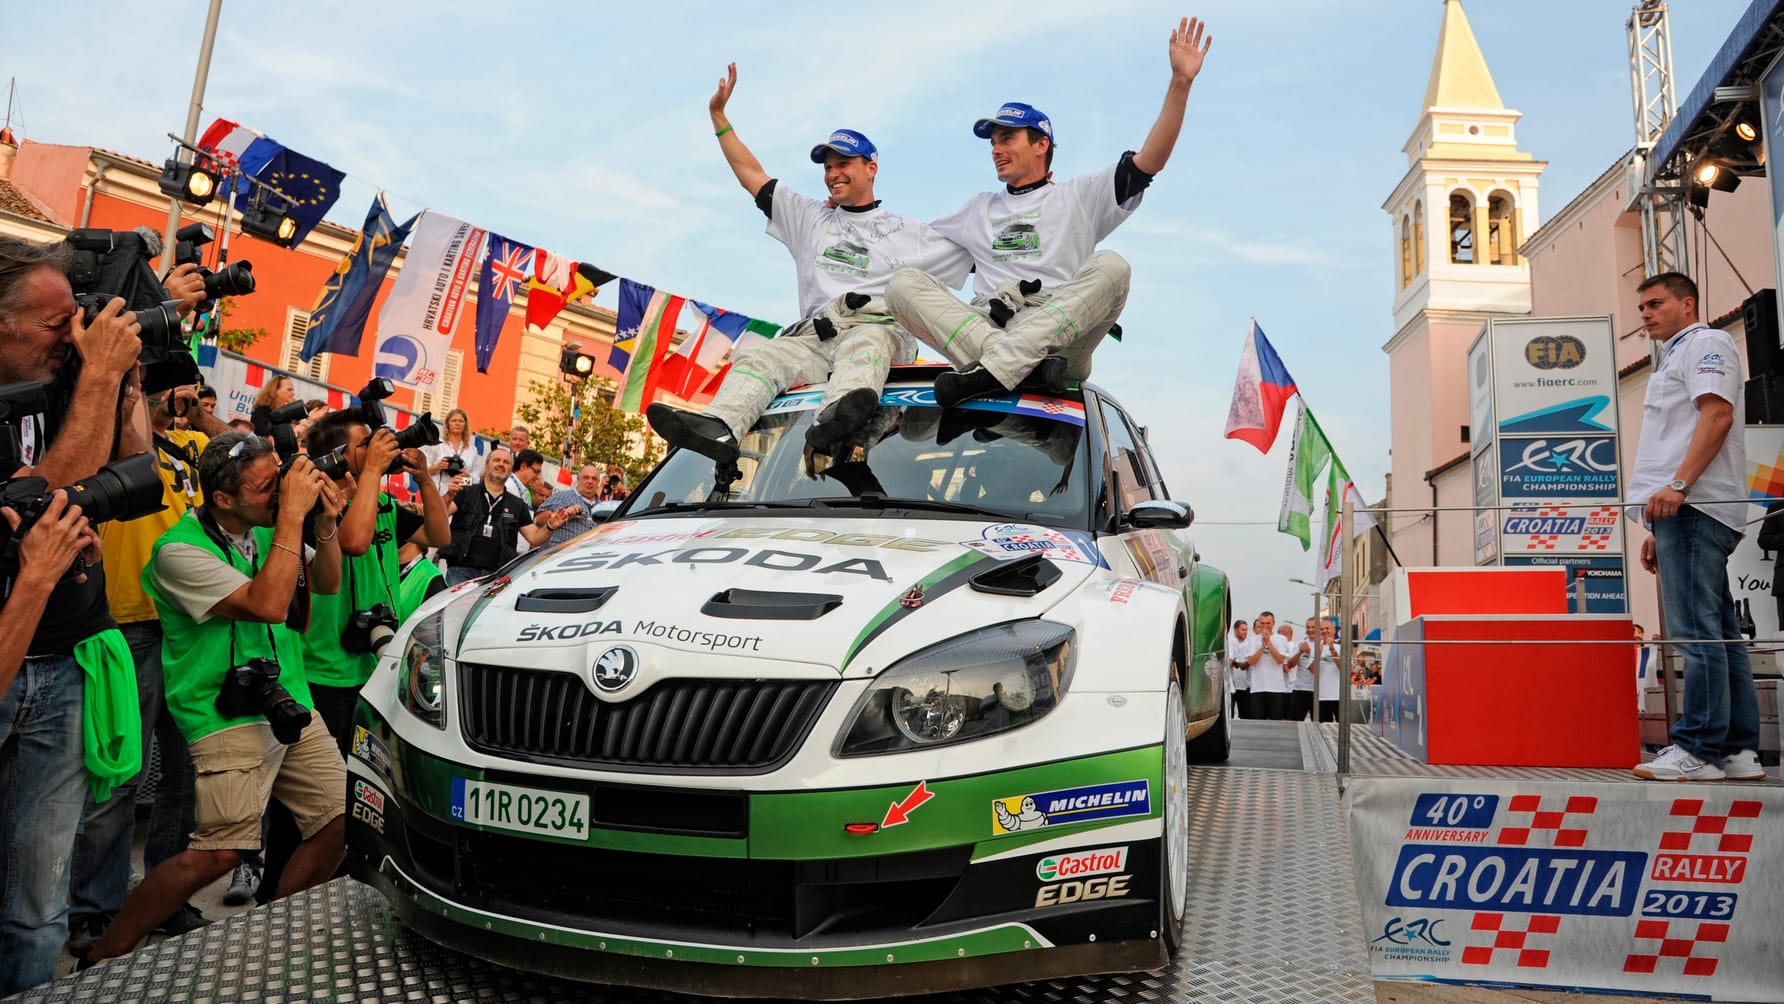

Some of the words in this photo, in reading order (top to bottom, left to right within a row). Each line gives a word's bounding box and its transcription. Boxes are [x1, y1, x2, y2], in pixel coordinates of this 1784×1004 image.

[423, 292, 442, 330] HRVATSKI
[435, 272, 449, 292] AUTO
[444, 240, 462, 267] KARTING
[1513, 377, 1597, 388] www.fiaerc.com
[229, 389, 257, 404] Unit
[1503, 475, 1521, 483] FIA
[1522, 483, 1616, 491] CHAMPIONSHIP
[1506, 519, 1580, 533] CROATIA
[1004, 541, 1054, 551] CROATIA
[544, 546, 890, 581] ŠKODA
[1559, 558, 1591, 566] partners
[517, 620, 622, 642] ŠKODA
[633, 620, 763, 651] Motorsport
[452, 805, 463, 818] CZ
[470, 787, 512, 824] 11R
[518, 793, 584, 833] 0234
[1049, 789, 1147, 812] MICHELIN
[352, 802, 385, 834] EDGE
[1404, 828, 1489, 843] ANNIVERSARY
[1058, 851, 1121, 876] Castrol
[1654, 856, 1744, 881] RALLY
[1035, 874, 1134, 908] EDGE
[1400, 853, 1629, 908] CROATIA
[1643, 894, 1735, 916] 2013
[1384, 954, 1450, 963] CHAMPIONSHIP
